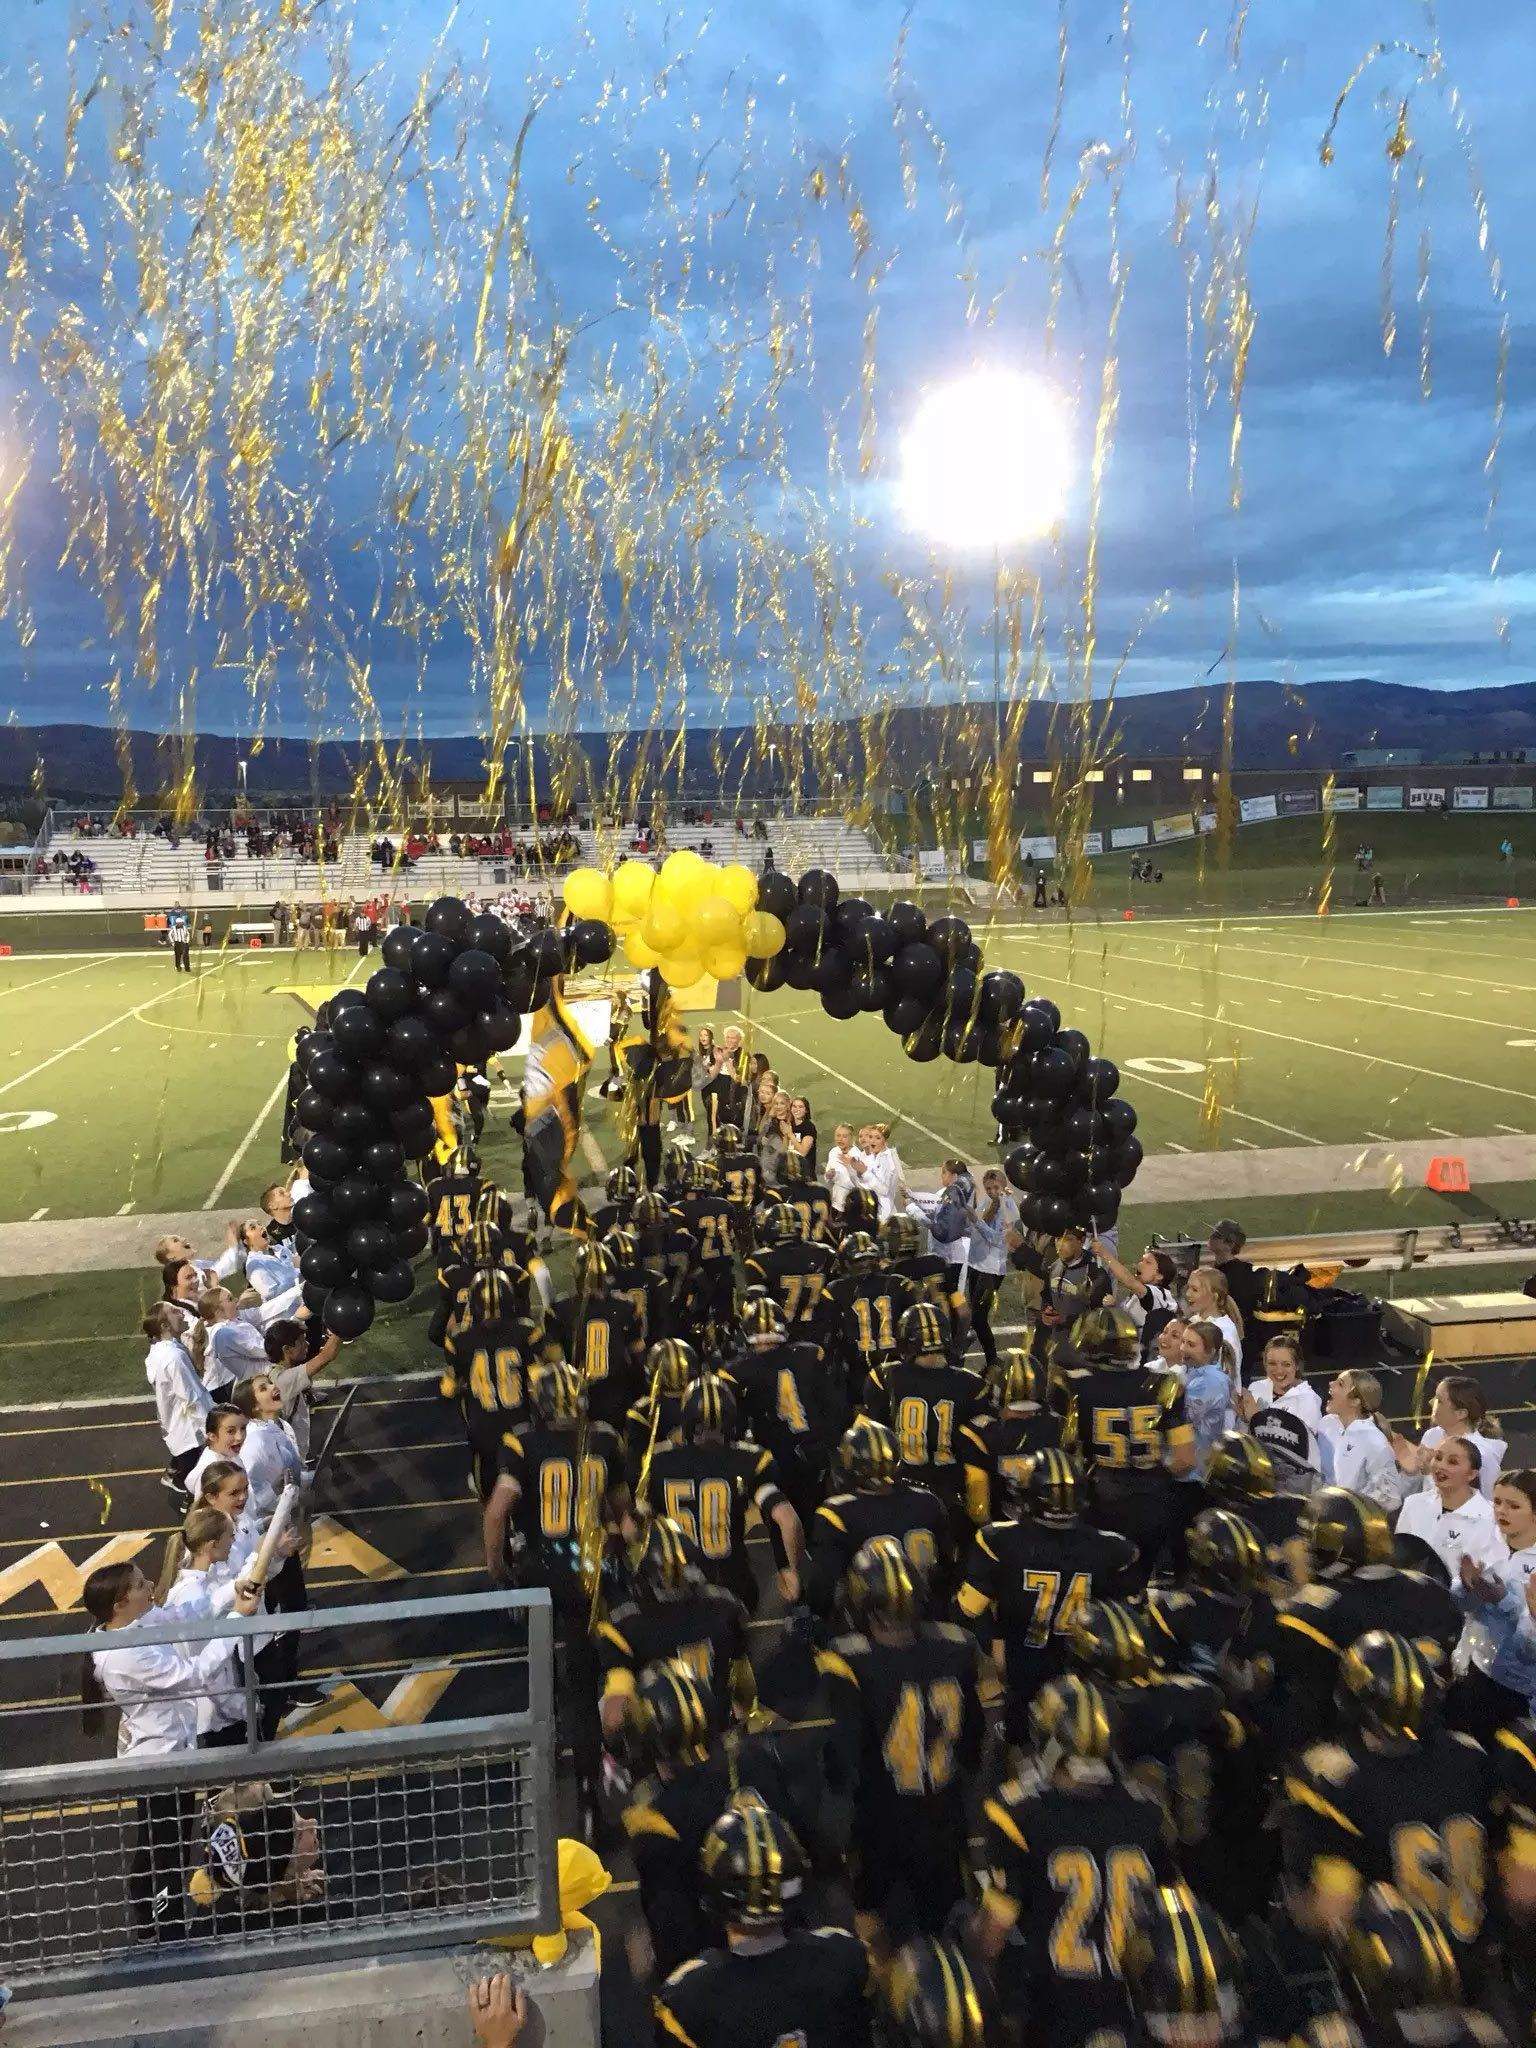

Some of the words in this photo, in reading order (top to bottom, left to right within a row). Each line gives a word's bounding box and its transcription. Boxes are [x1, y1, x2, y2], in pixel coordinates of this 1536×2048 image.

[435, 1193, 472, 1236] 43
[699, 1213, 734, 1260] 21
[780, 1273, 825, 1322] 77
[851, 1296, 897, 1352] 11
[469, 1347, 523, 1412] 46
[586, 1318, 610, 1379] 8
[899, 1396, 957, 1466] 81
[1092, 1404, 1163, 1470] 55
[663, 1477, 732, 1560] 50
[1023, 1568, 1093, 1649] 74
